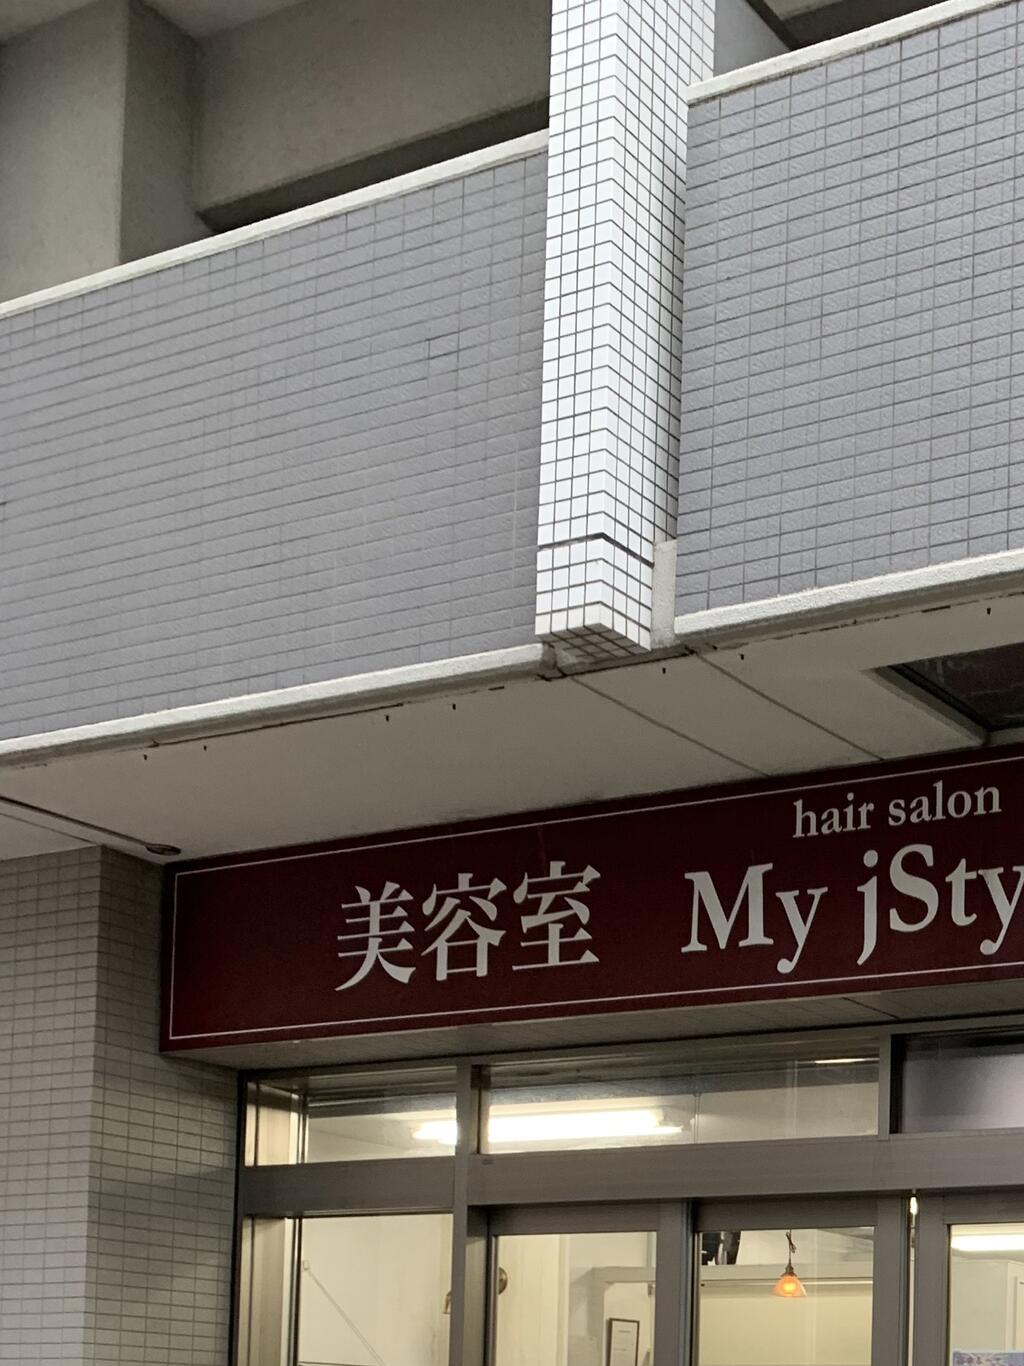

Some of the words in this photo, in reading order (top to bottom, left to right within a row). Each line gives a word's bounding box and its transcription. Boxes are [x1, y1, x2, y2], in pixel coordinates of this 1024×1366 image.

[793, 794, 875, 839] hair
[888, 781, 1002, 828] salon
[335, 860, 600, 991] 美容室
[681, 862, 824, 974] My
